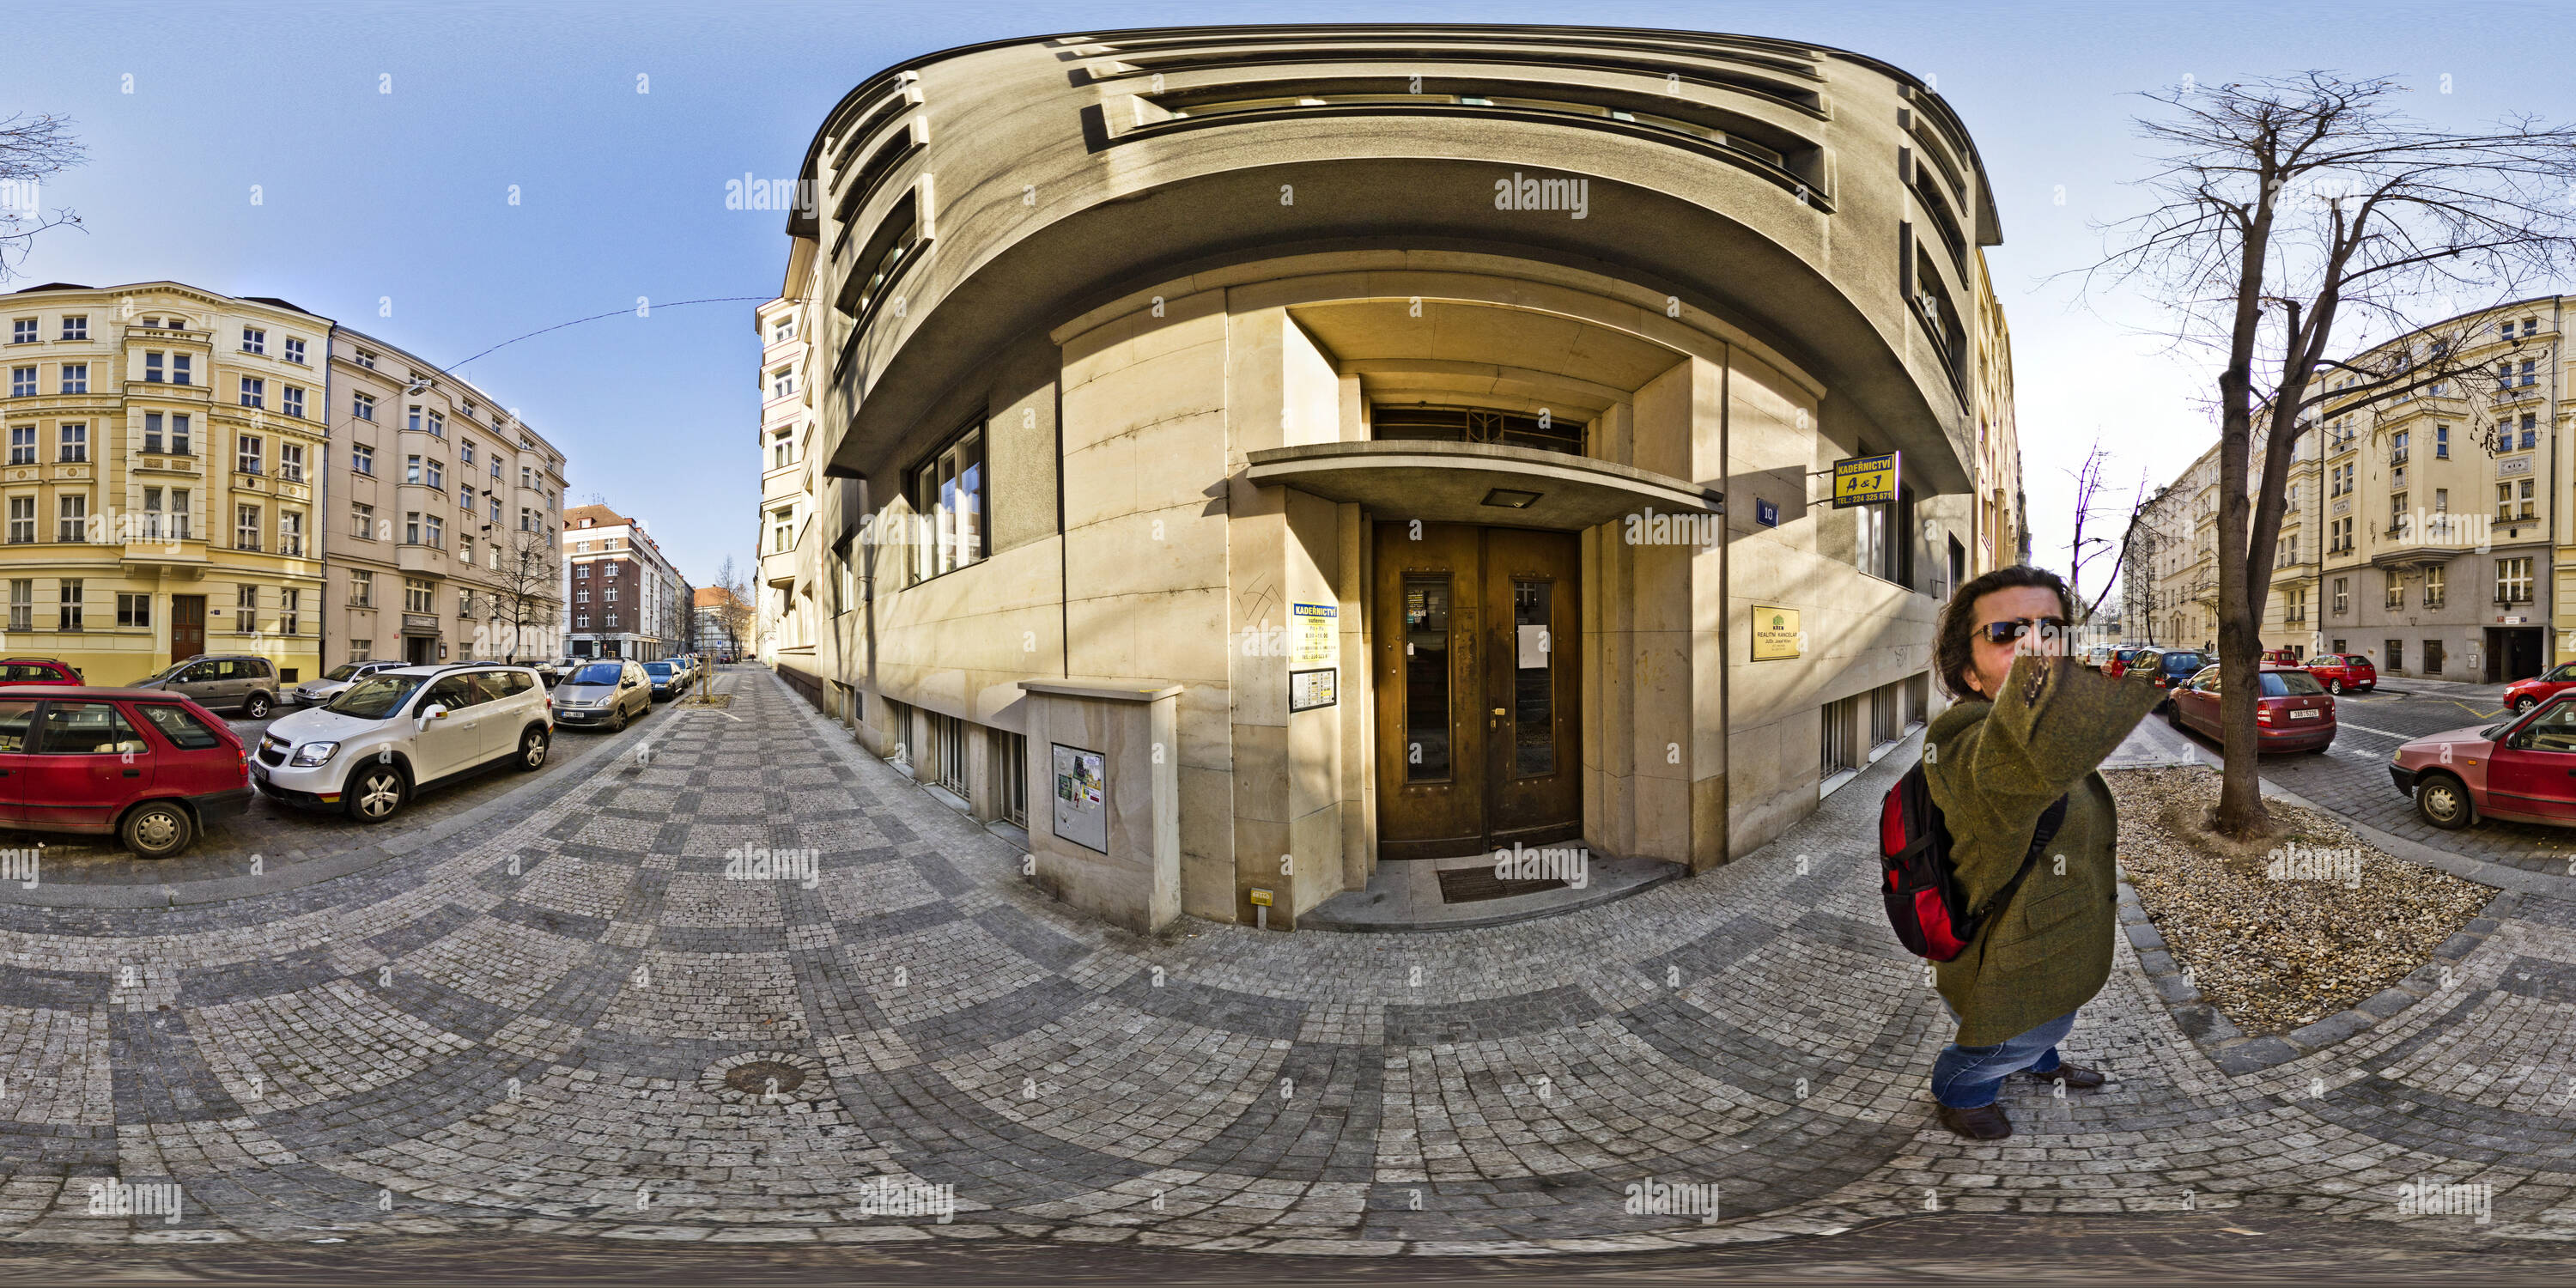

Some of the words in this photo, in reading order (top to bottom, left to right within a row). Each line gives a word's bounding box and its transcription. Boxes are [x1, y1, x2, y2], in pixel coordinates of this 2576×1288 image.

[1838, 457, 1892, 475] KADEŘNICTVÍ
[1846, 477, 1857, 493] A
[1861, 479, 1869, 488] &
[1872, 474, 1882, 490] J
[1765, 507, 1773, 520] 10
[1296, 605, 1336, 617] KADEŘNICTVÍ
